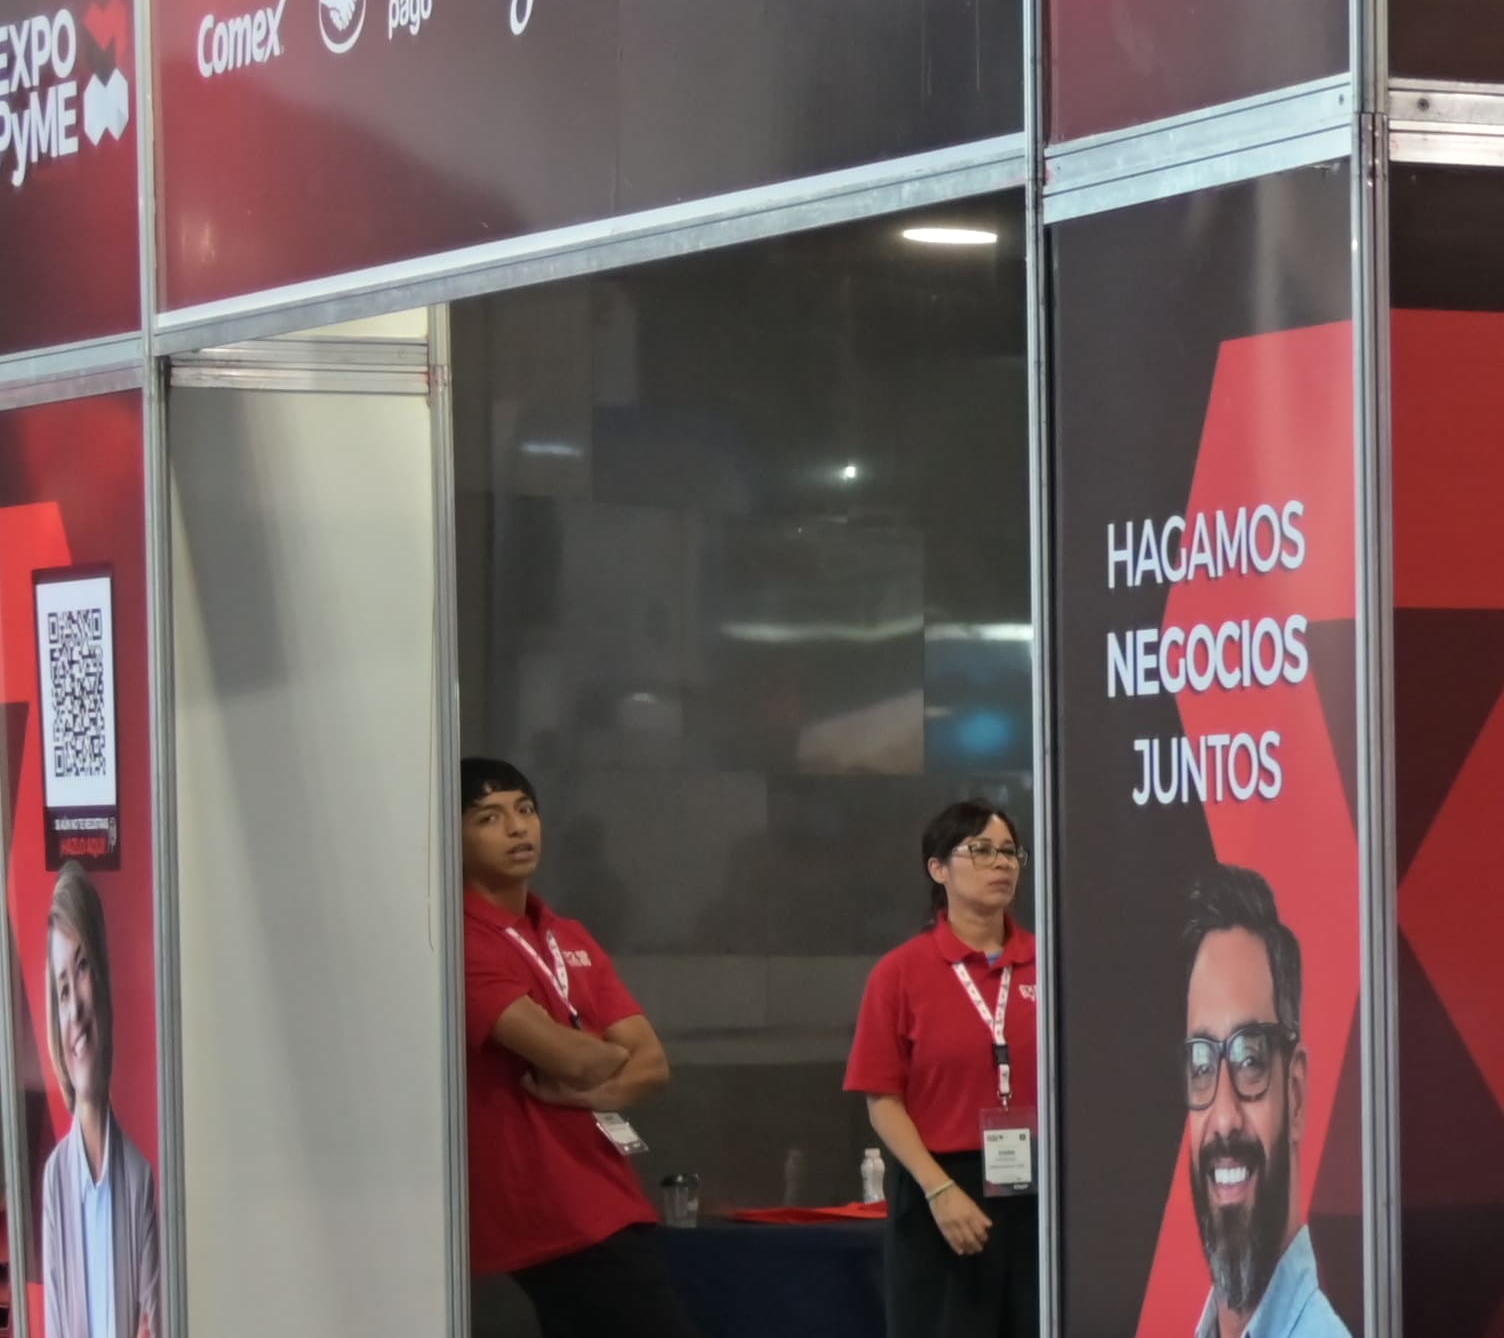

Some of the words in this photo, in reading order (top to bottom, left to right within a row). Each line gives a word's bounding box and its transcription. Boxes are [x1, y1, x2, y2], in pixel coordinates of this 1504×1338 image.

[1107, 499, 1306, 589] HAGAMOS
[1107, 613, 1309, 698] NEGOCIOS
[1132, 730, 1282, 806] JUNTOS
